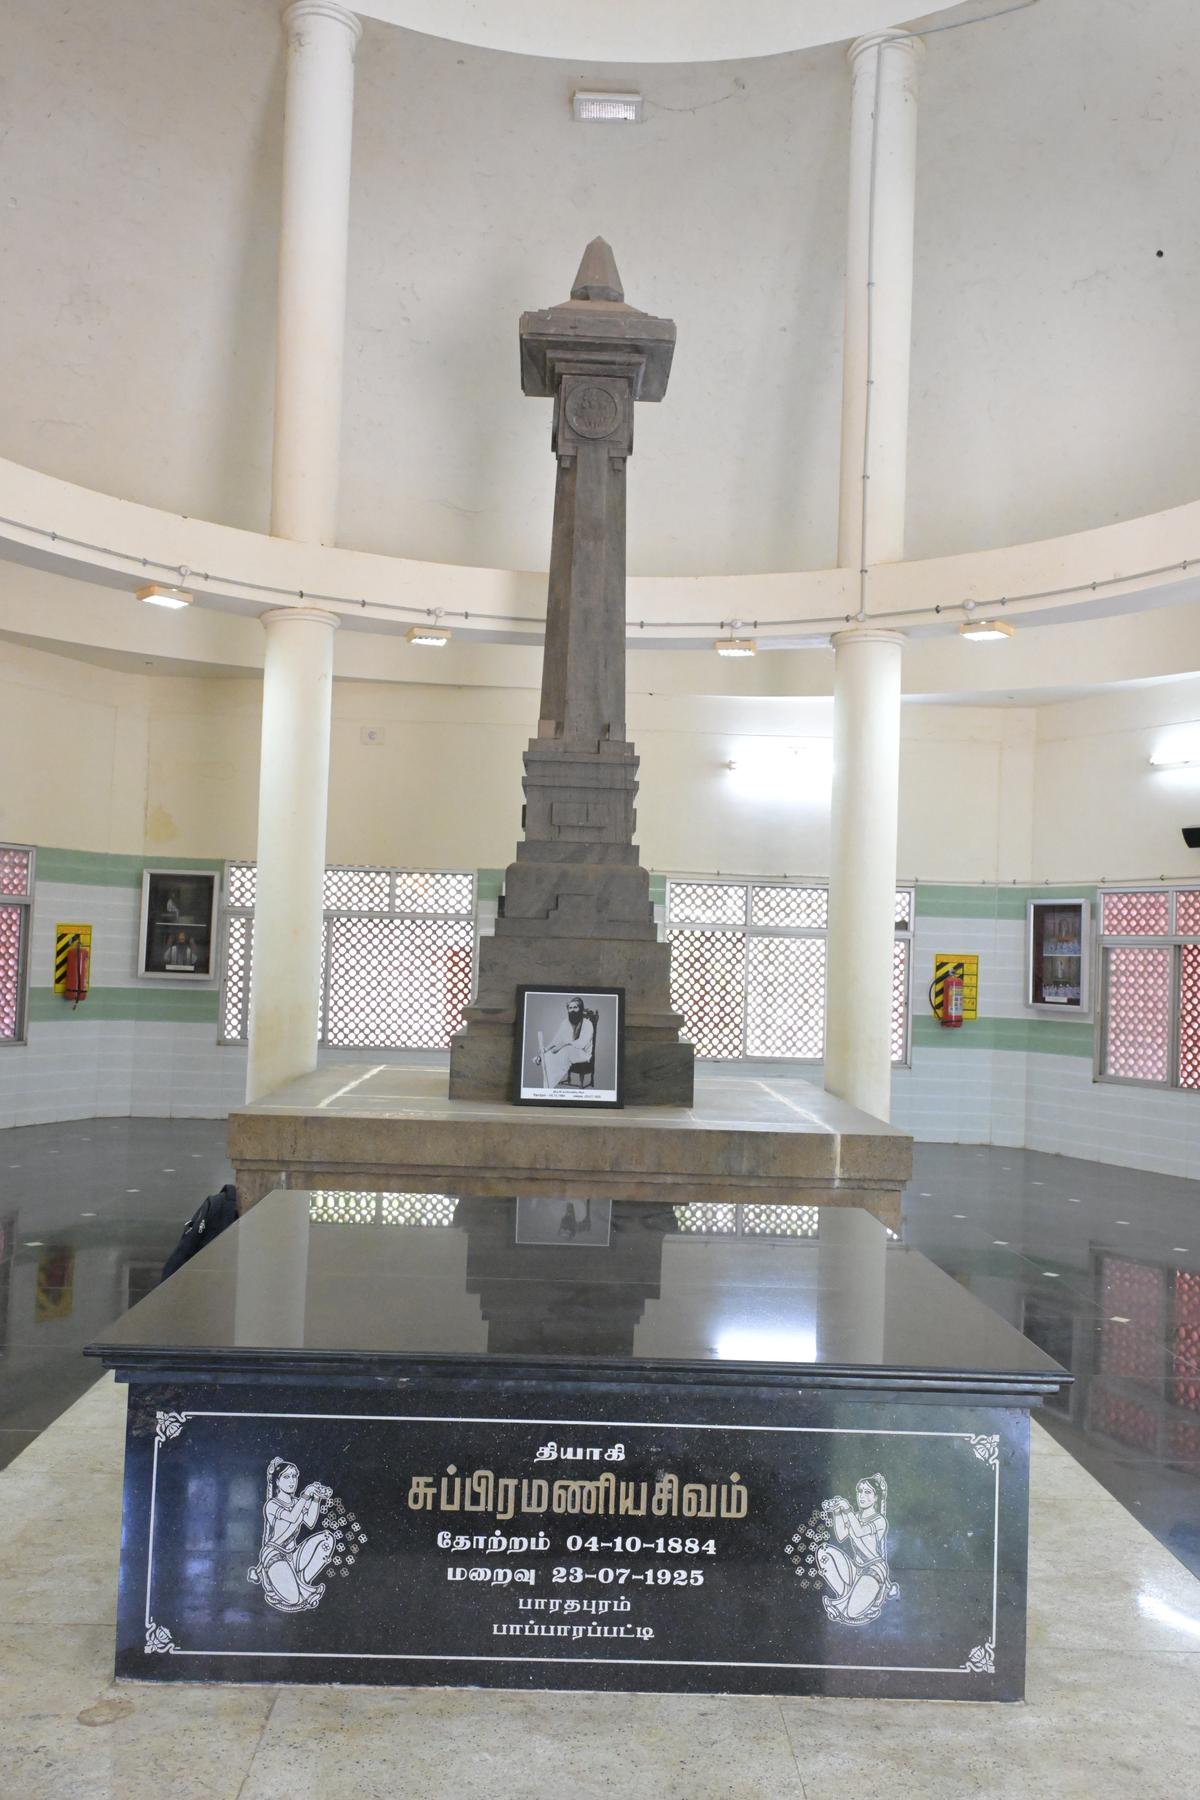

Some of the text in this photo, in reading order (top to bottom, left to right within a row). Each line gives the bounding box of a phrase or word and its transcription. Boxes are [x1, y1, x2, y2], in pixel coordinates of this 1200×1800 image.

[533, 1441, 626, 1463] தியாகி
[407, 1463, 748, 1520] சுப்பிரமணியசிவம்
[437, 1530, 717, 1555] தோற்றம் 04-10-1884
[447, 1566, 704, 1586] மறைவு 23-07-1925
[518, 1595, 631, 1613] பாரதபுரம்
[492, 1620, 655, 1640] பாப்பாரப்பட்டி
